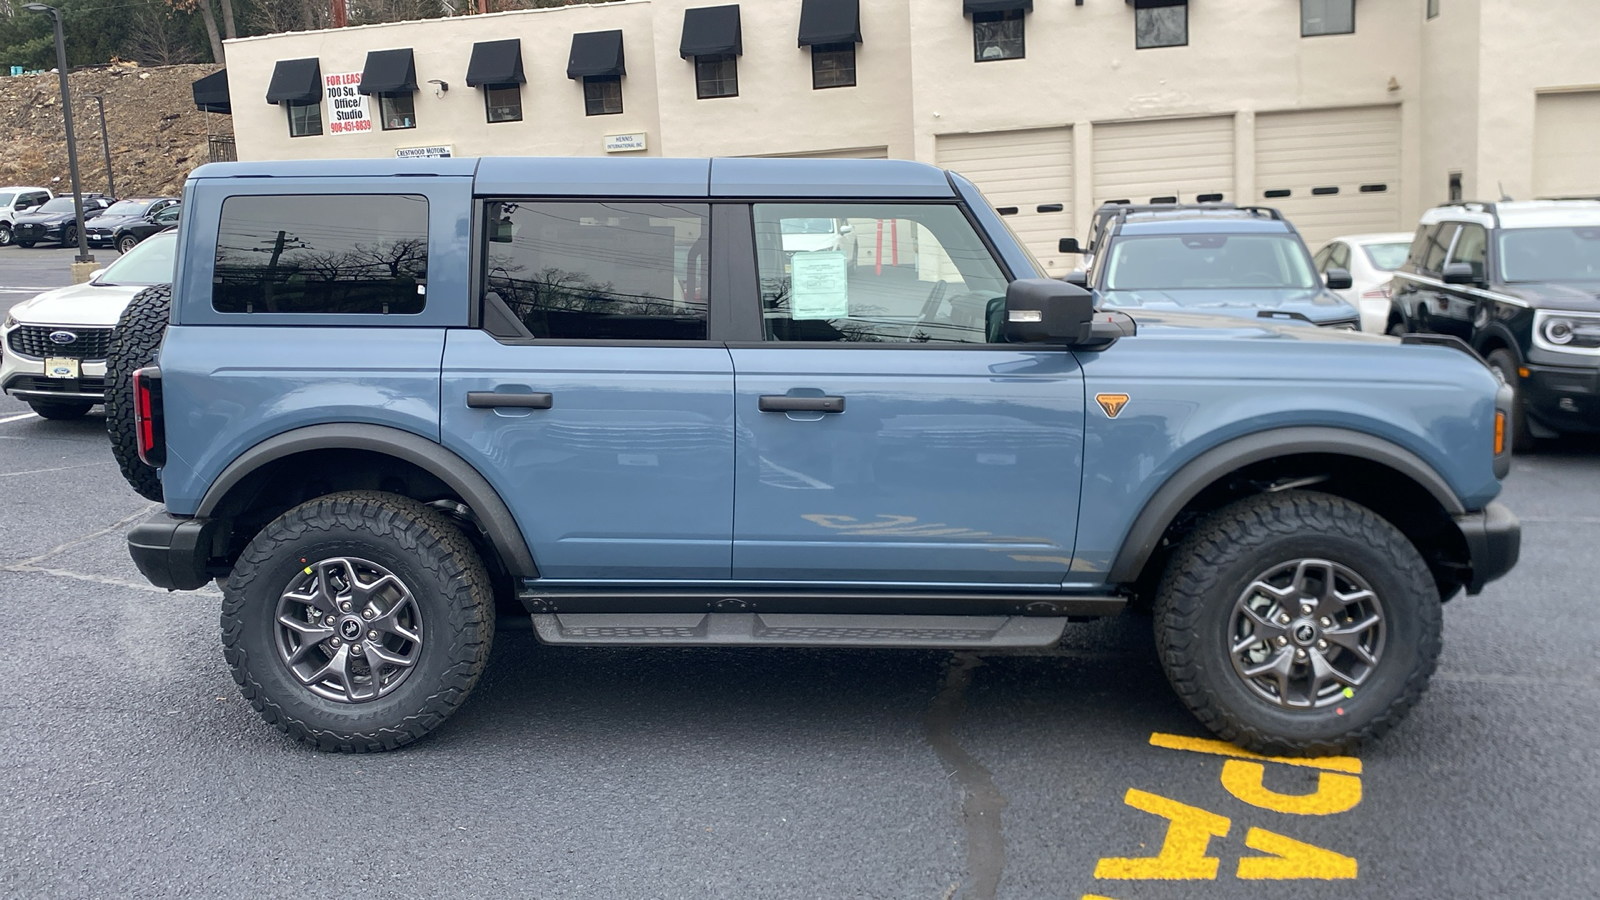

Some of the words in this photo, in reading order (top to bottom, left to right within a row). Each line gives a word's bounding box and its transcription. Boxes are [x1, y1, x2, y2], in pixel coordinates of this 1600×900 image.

[326, 75, 341, 86] FOR
[327, 87, 342, 98] 700
[343, 86, 356, 97] Sq.
[334, 97, 362, 109] Office/
[336, 109, 363, 121] Studio
[396, 148, 425, 157] CRESTWOOD
[426, 146, 446, 154] MOTORS
